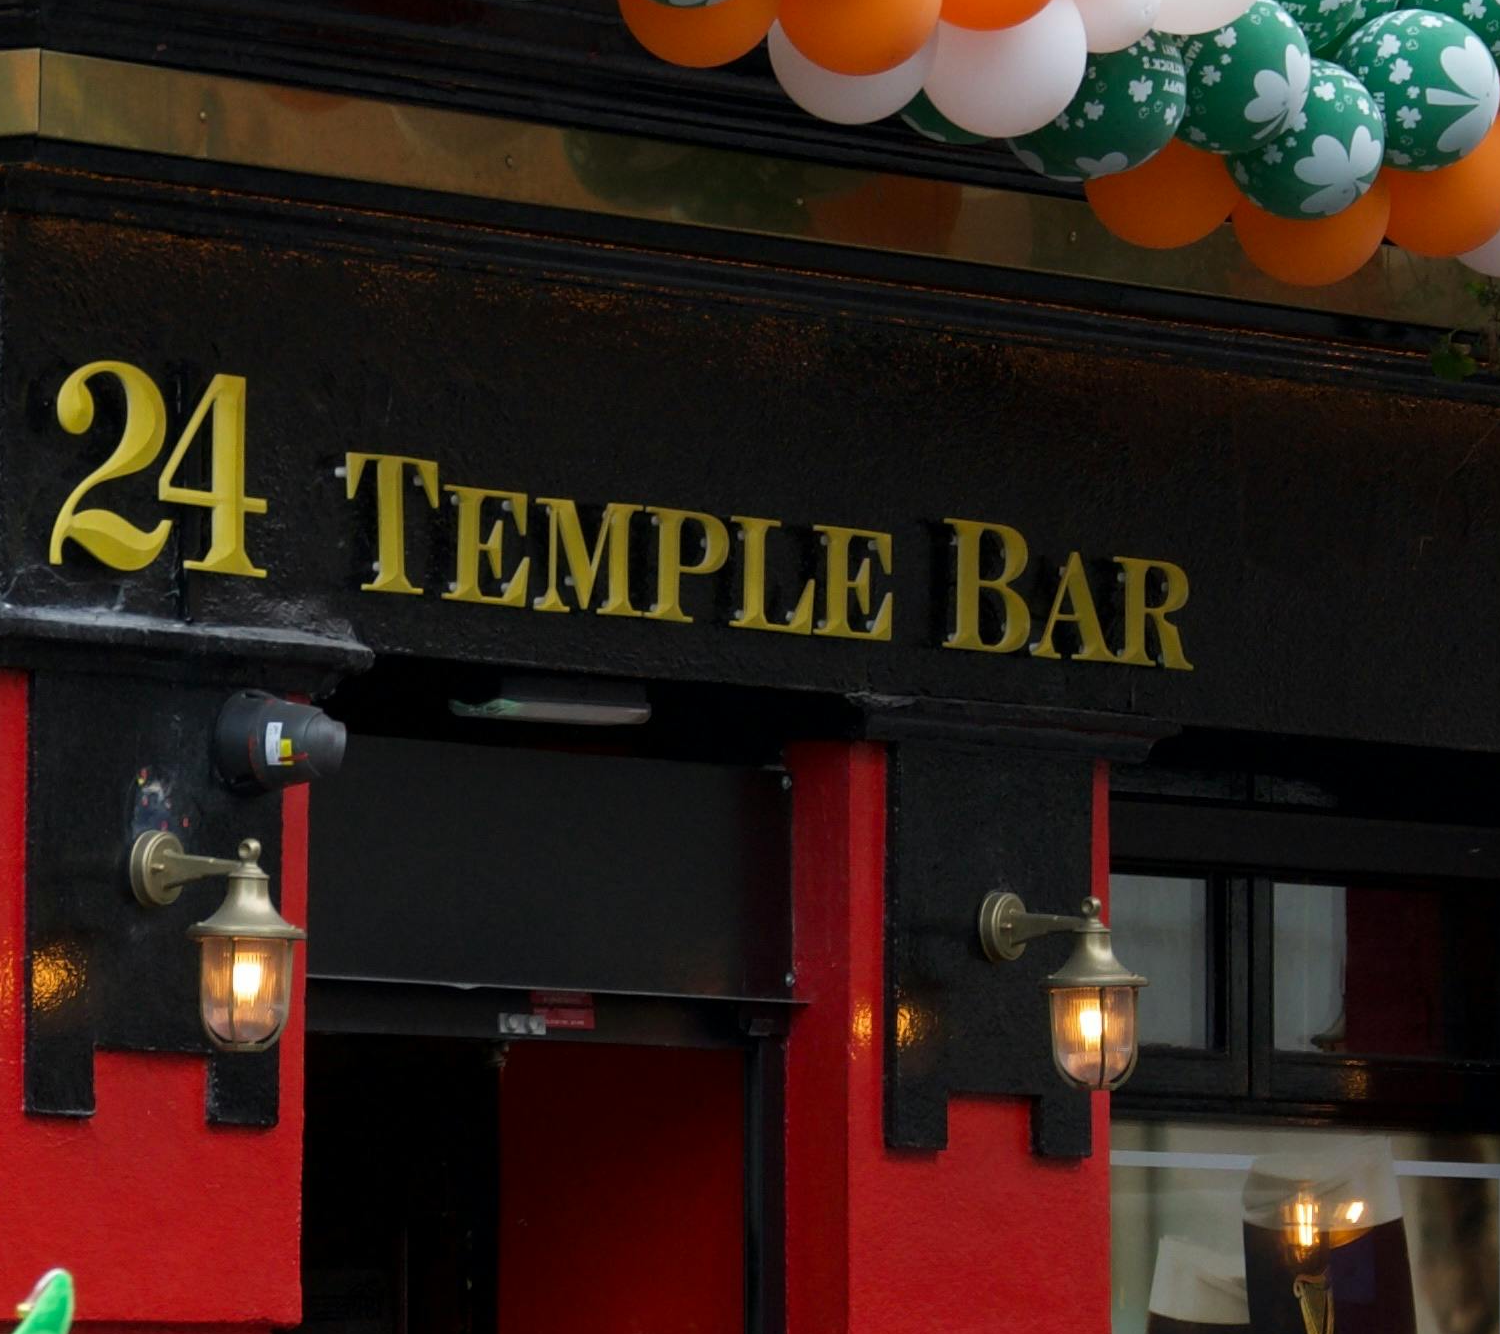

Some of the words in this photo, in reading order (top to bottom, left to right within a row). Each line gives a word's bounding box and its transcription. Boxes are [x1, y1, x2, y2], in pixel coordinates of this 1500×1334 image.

[48, 359, 268, 579] 24
[344, 451, 893, 642] TEMPLE
[940, 517, 1195, 670] BAR
